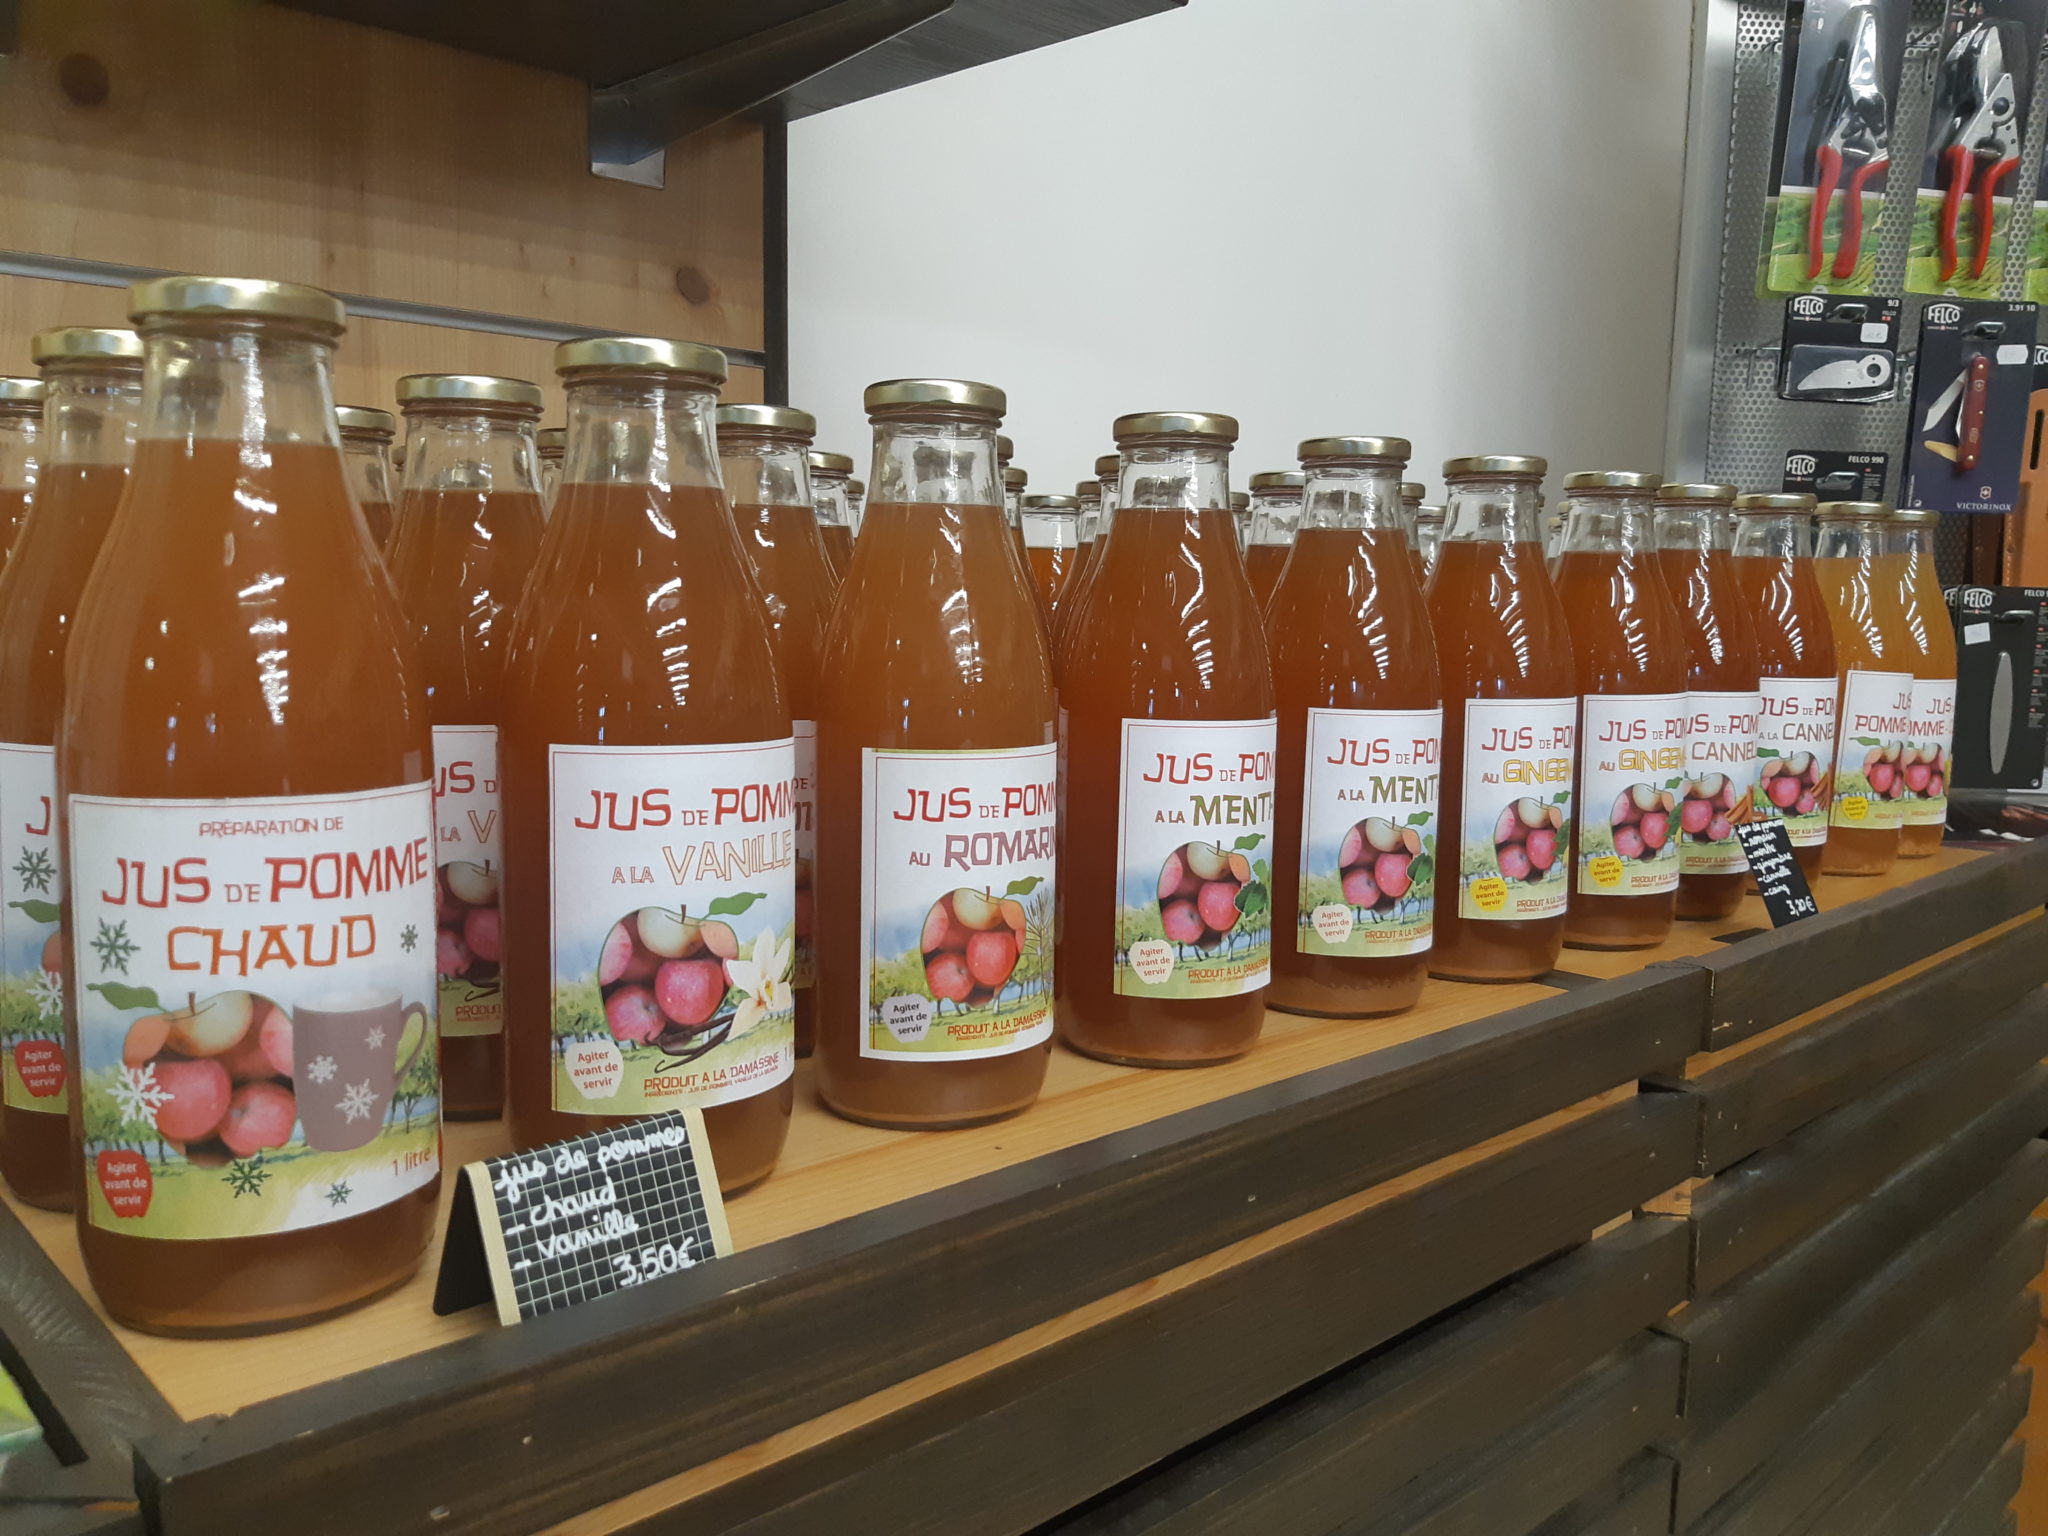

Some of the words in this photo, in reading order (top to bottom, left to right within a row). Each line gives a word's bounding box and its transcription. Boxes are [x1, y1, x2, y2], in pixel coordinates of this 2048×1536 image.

[1793, 295, 1824, 315] FELCO
[1887, 299, 1900, 307] 9/3
[1928, 303, 1960, 323] FELCO
[1786, 454, 1816, 475] FELCO
[1848, 455, 1870, 463] FELCO
[1956, 502, 2012, 511] VICTORINOX
[1963, 587, 1993, 608] FELCO
[2024, 589, 2045, 597] FELCO
[1759, 696, 1799, 717] JUS
[1802, 707, 1814, 716] DE
[1926, 697, 1952, 715] JUS
[1599, 719, 1647, 743] JUS
[1652, 730, 1664, 740] DE
[1713, 724, 1727, 734] DE
[1767, 732, 1779, 741] LA
[1481, 727, 1533, 751] JUS
[1539, 739, 1552, 750] DE
[1327, 738, 1390, 766] JUS
[1395, 753, 1410, 765] DE
[1691, 741, 1758, 762] CANNEL
[1143, 753, 1213, 784] JUS
[1219, 769, 1236, 782] DE
[1598, 761, 1616, 772] AU
[1481, 772, 1500, 784] AU
[1337, 789, 1347, 801] A
[1350, 789, 1365, 801] LA
[574, 788, 673, 832] JUS
[681, 807, 708, 826] DE
[711, 782, 796, 826] POMM
[893, 787, 972, 822] JUS
[979, 805, 1000, 819] DE
[1155, 810, 1166, 823] A
[1169, 810, 1185, 824] LA
[199, 817, 319, 837] PRÉPARATION
[324, 816, 344, 832] DE
[612, 867, 626, 884] A
[629, 865, 654, 884] LA
[662, 829, 793, 886] VANILLE
[909, 851, 931, 867] AU
[102, 857, 212, 908] JUS
[224, 883, 261, 903] DE
[264, 836, 430, 902] POMME
[1478, 883, 1499, 892] Agiter
[1475, 892, 1495, 900] avant
[1481, 899, 1500, 907] servir
[1516, 898, 1544, 908] PRODUIT
[1318, 920, 1339, 929] avant
[1339, 917, 1350, 926] de
[1321, 910, 1344, 921] Agiter
[1324, 928, 1346, 937] servir
[1364, 930, 1398, 940] PRODUIT
[1404, 927, 1412, 937] LA
[167, 914, 377, 976] CHAUD
[1139, 946, 1164, 958] Agiter
[1136, 958, 1158, 968] avant
[1160, 956, 1171, 965] de
[1143, 966, 1166, 977] servir
[1188, 967, 1225, 980] PRODUIT
[1226, 967, 1232, 976] A
[1233, 965, 1242, 975] LA
[892, 1002, 920, 1015] Agiter
[889, 1014, 914, 1025] avant
[914, 1011, 928, 1022] de
[897, 1023, 923, 1036] servir
[947, 1023, 990, 1038] PRODUIT
[992, 1021, 999, 1032] A
[1000, 1019, 1011, 1030] LA
[24, 1049, 52, 1062] Agiter
[577, 1049, 610, 1067] Agiter
[21, 1062, 47, 1074] avant
[48, 1061, 62, 1073] de
[573, 1064, 601, 1078] avant
[604, 1062, 619, 1076] de
[643, 1074, 699, 1092] PRODUIT
[702, 1072, 710, 1084] A
[713, 1069, 727, 1082] LA
[730, 1051, 780, 1078] DAMASSINE
[29, 1075, 57, 1088] servir
[583, 1075, 614, 1091] servir
[404, 1146, 432, 1173] litre
[494, 1159, 548, 1203] jus
[554, 1147, 589, 1175] de
[598, 1125, 686, 1172] pommes
[106, 1160, 138, 1176] Agiter
[104, 1177, 132, 1190] avant
[133, 1176, 148, 1189] de
[112, 1193, 142, 1206] servir
[530, 1175, 616, 1227] chaud
[536, 1208, 640, 1259] vanille
[612, 1236, 697, 1287] 3,50€
